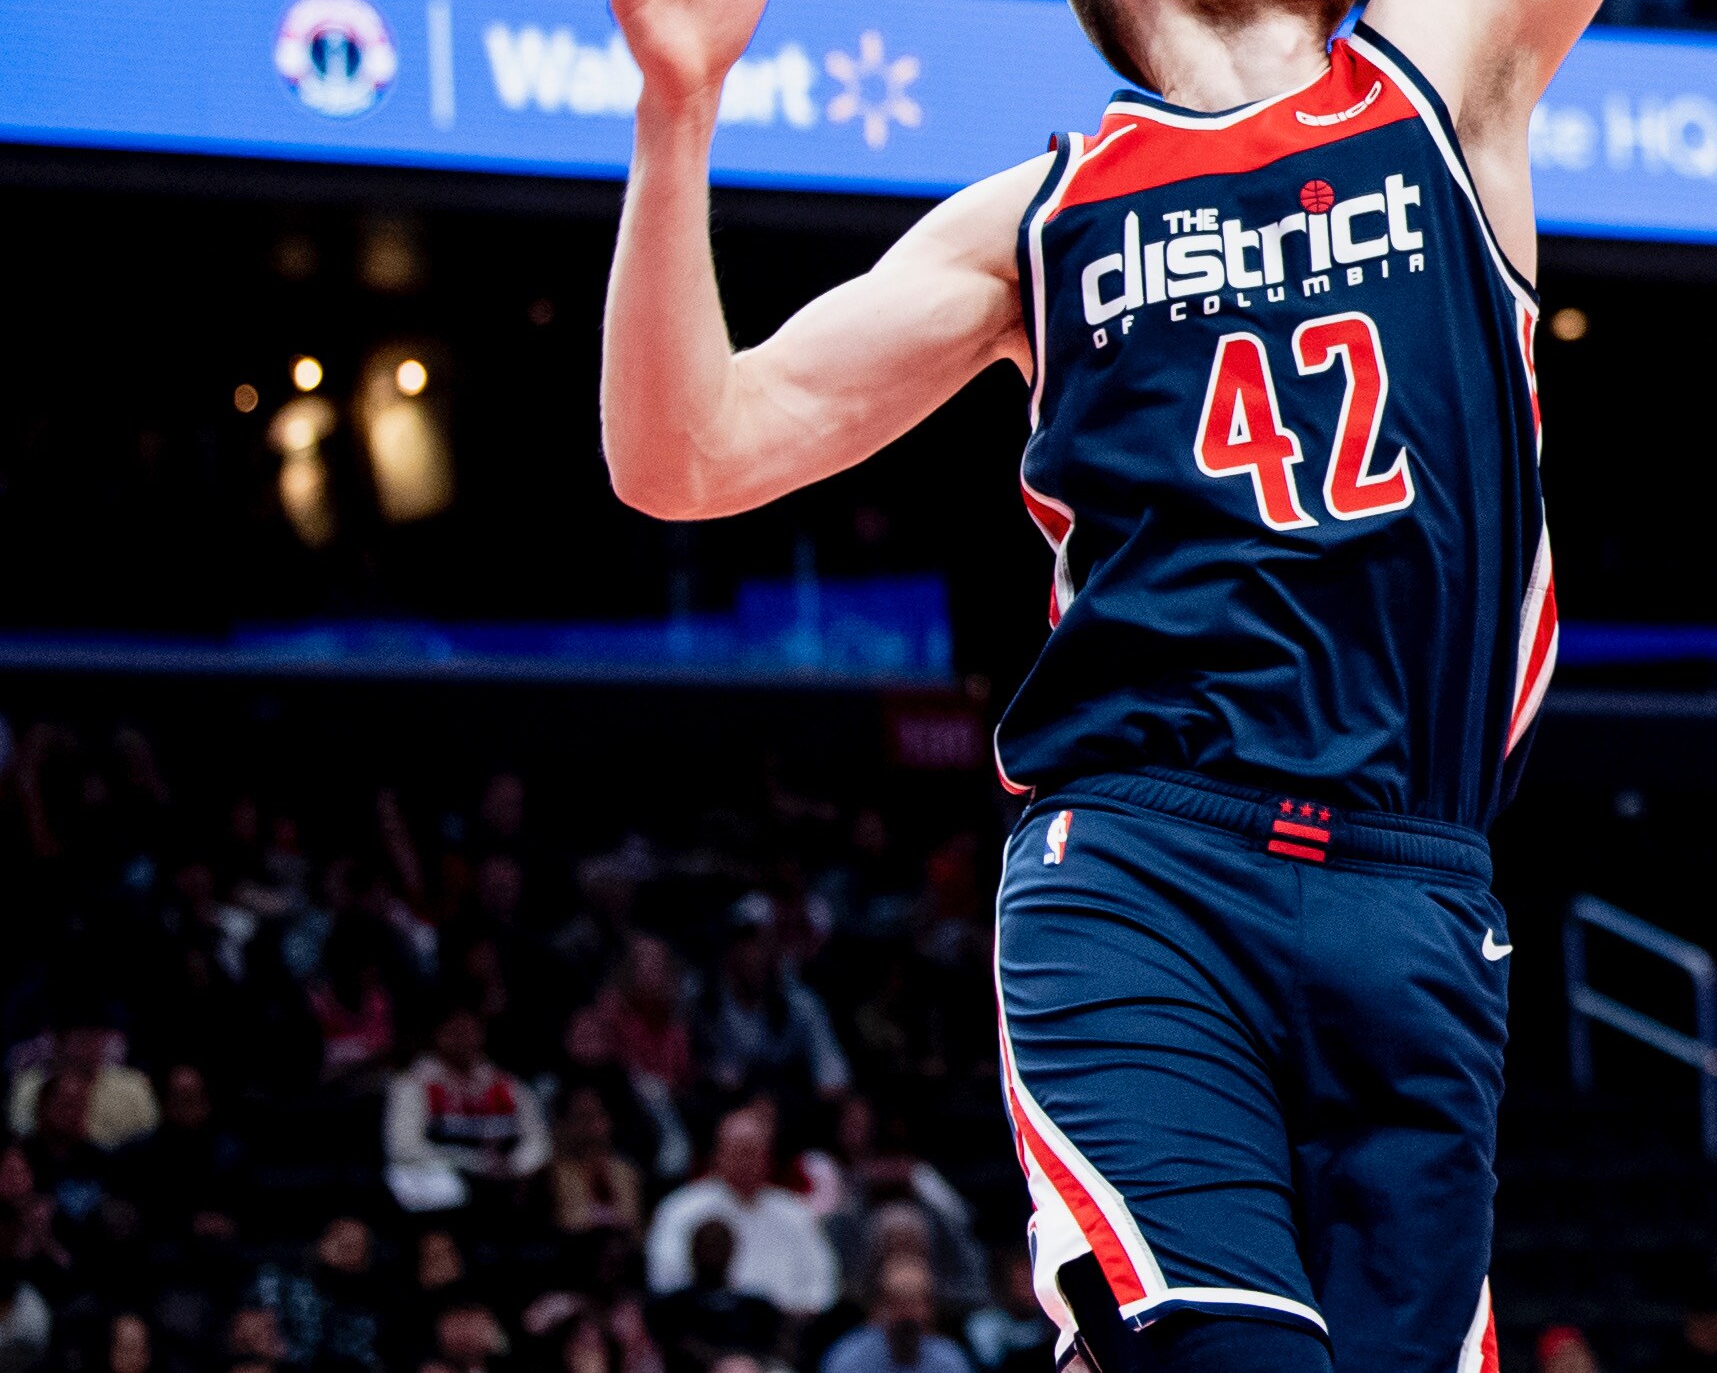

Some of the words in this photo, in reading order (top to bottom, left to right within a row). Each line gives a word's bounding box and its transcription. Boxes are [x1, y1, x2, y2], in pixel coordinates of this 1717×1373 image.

[484, 21, 818, 129] Walart
[1295, 81, 1383, 127] GEICO
[1080, 173, 1425, 327] district
[1162, 208, 1219, 235] THE
[1092, 314, 1135, 349] OF
[1170, 252, 1425, 322] COLUMBIA
[1193, 311, 1415, 531] 42
